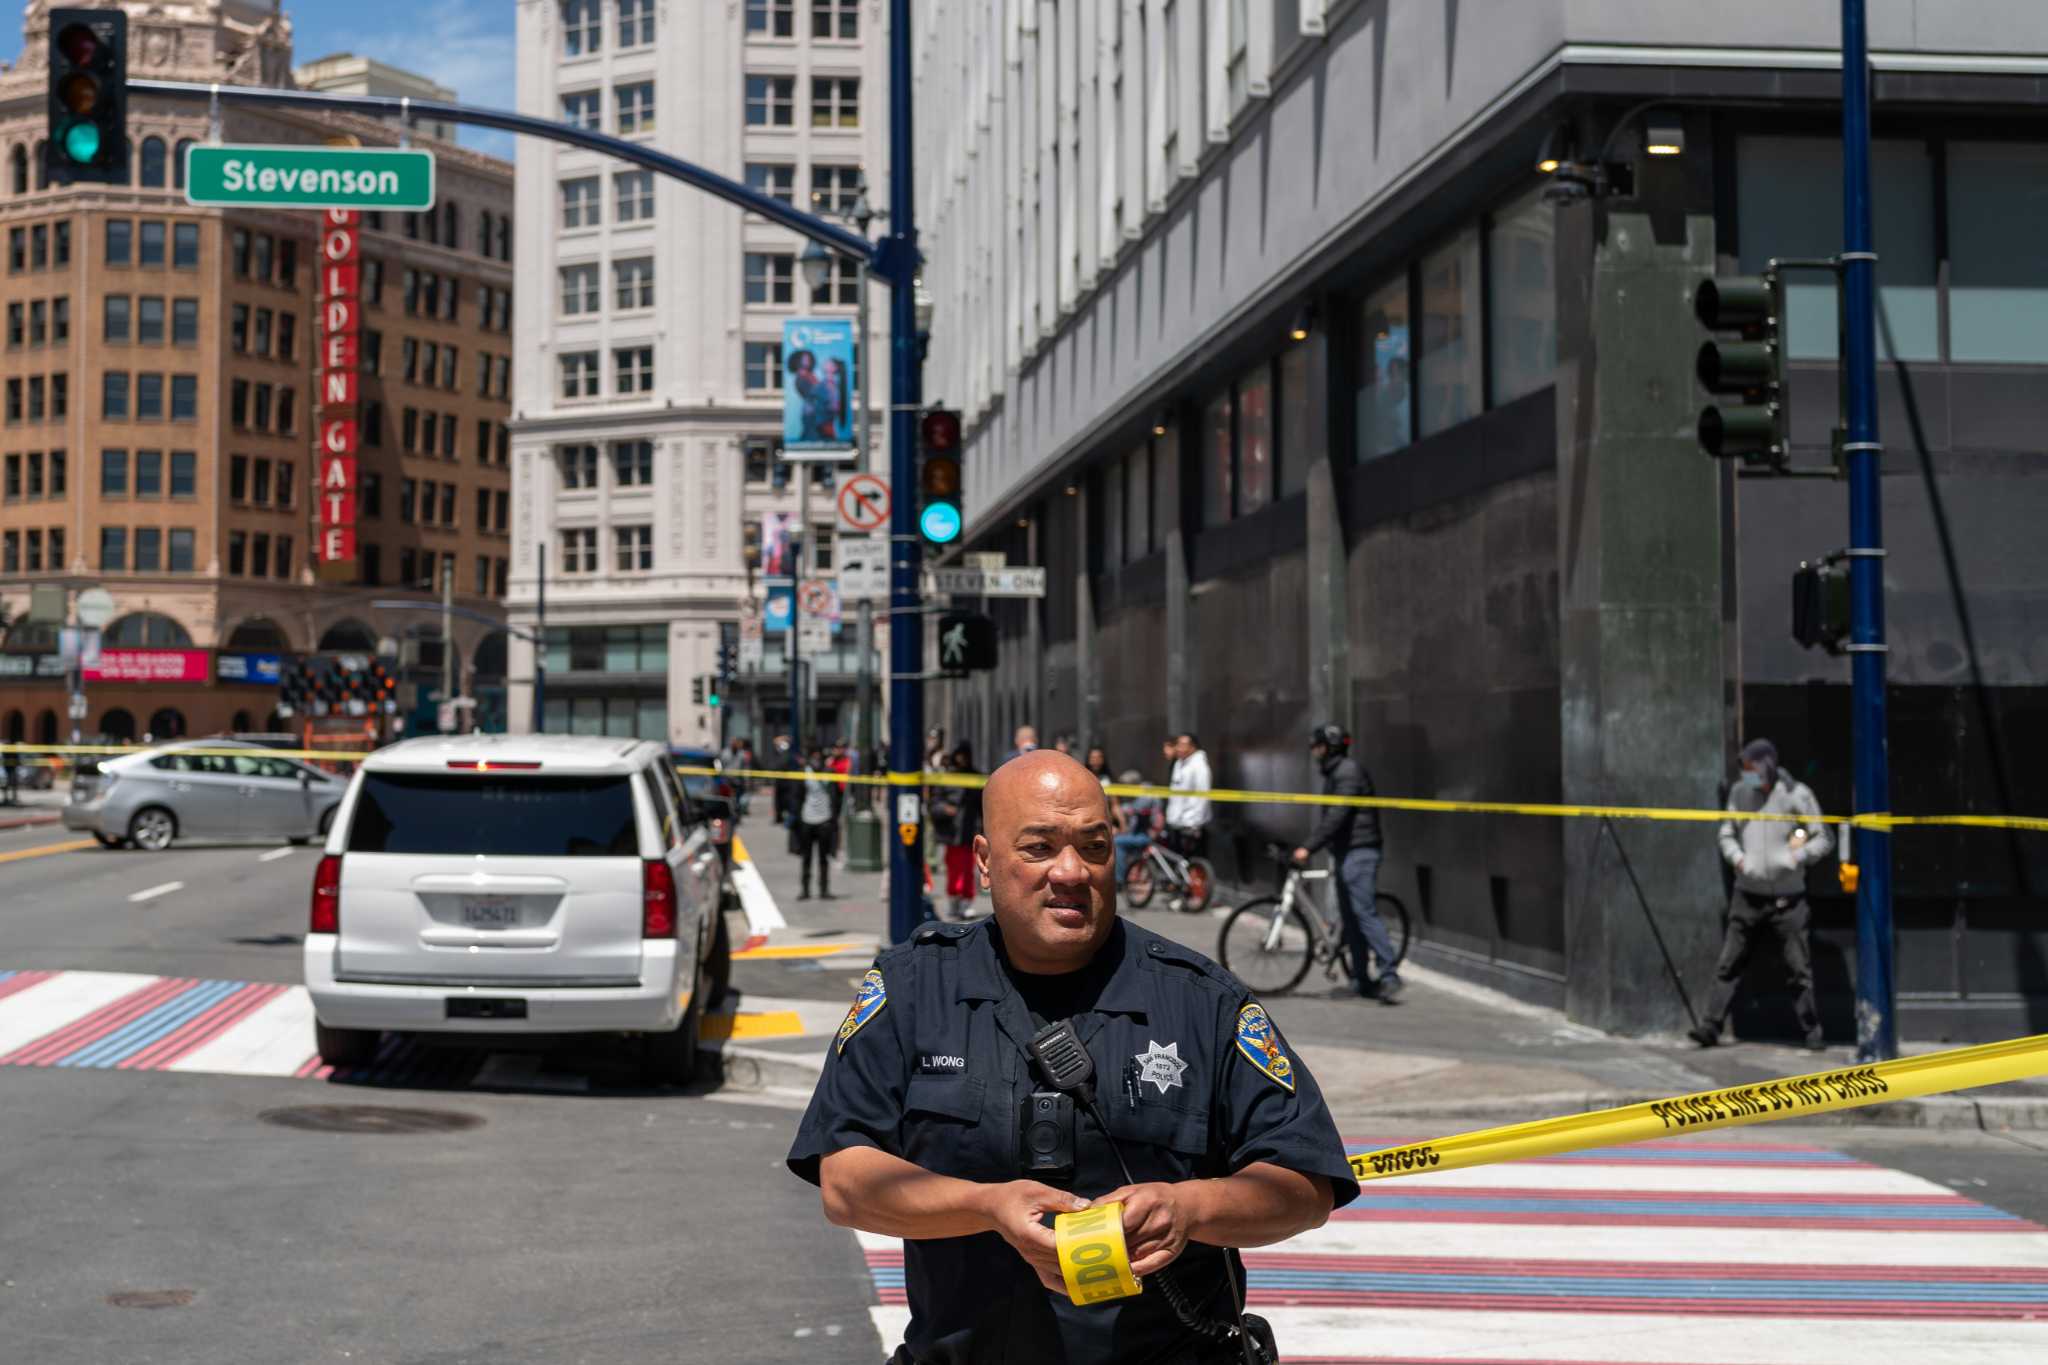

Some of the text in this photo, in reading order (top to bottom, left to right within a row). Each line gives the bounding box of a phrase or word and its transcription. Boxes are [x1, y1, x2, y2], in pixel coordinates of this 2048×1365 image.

[222, 159, 399, 195] Stevenson
[326, 421, 347, 561] GATE
[932, 1055, 965, 1067] WONG
[1151, 1070, 1175, 1081] POLICE
[1651, 1067, 1889, 1128] POLICE LINE DO NOT CROSS
[1070, 1243, 1119, 1286] DO
